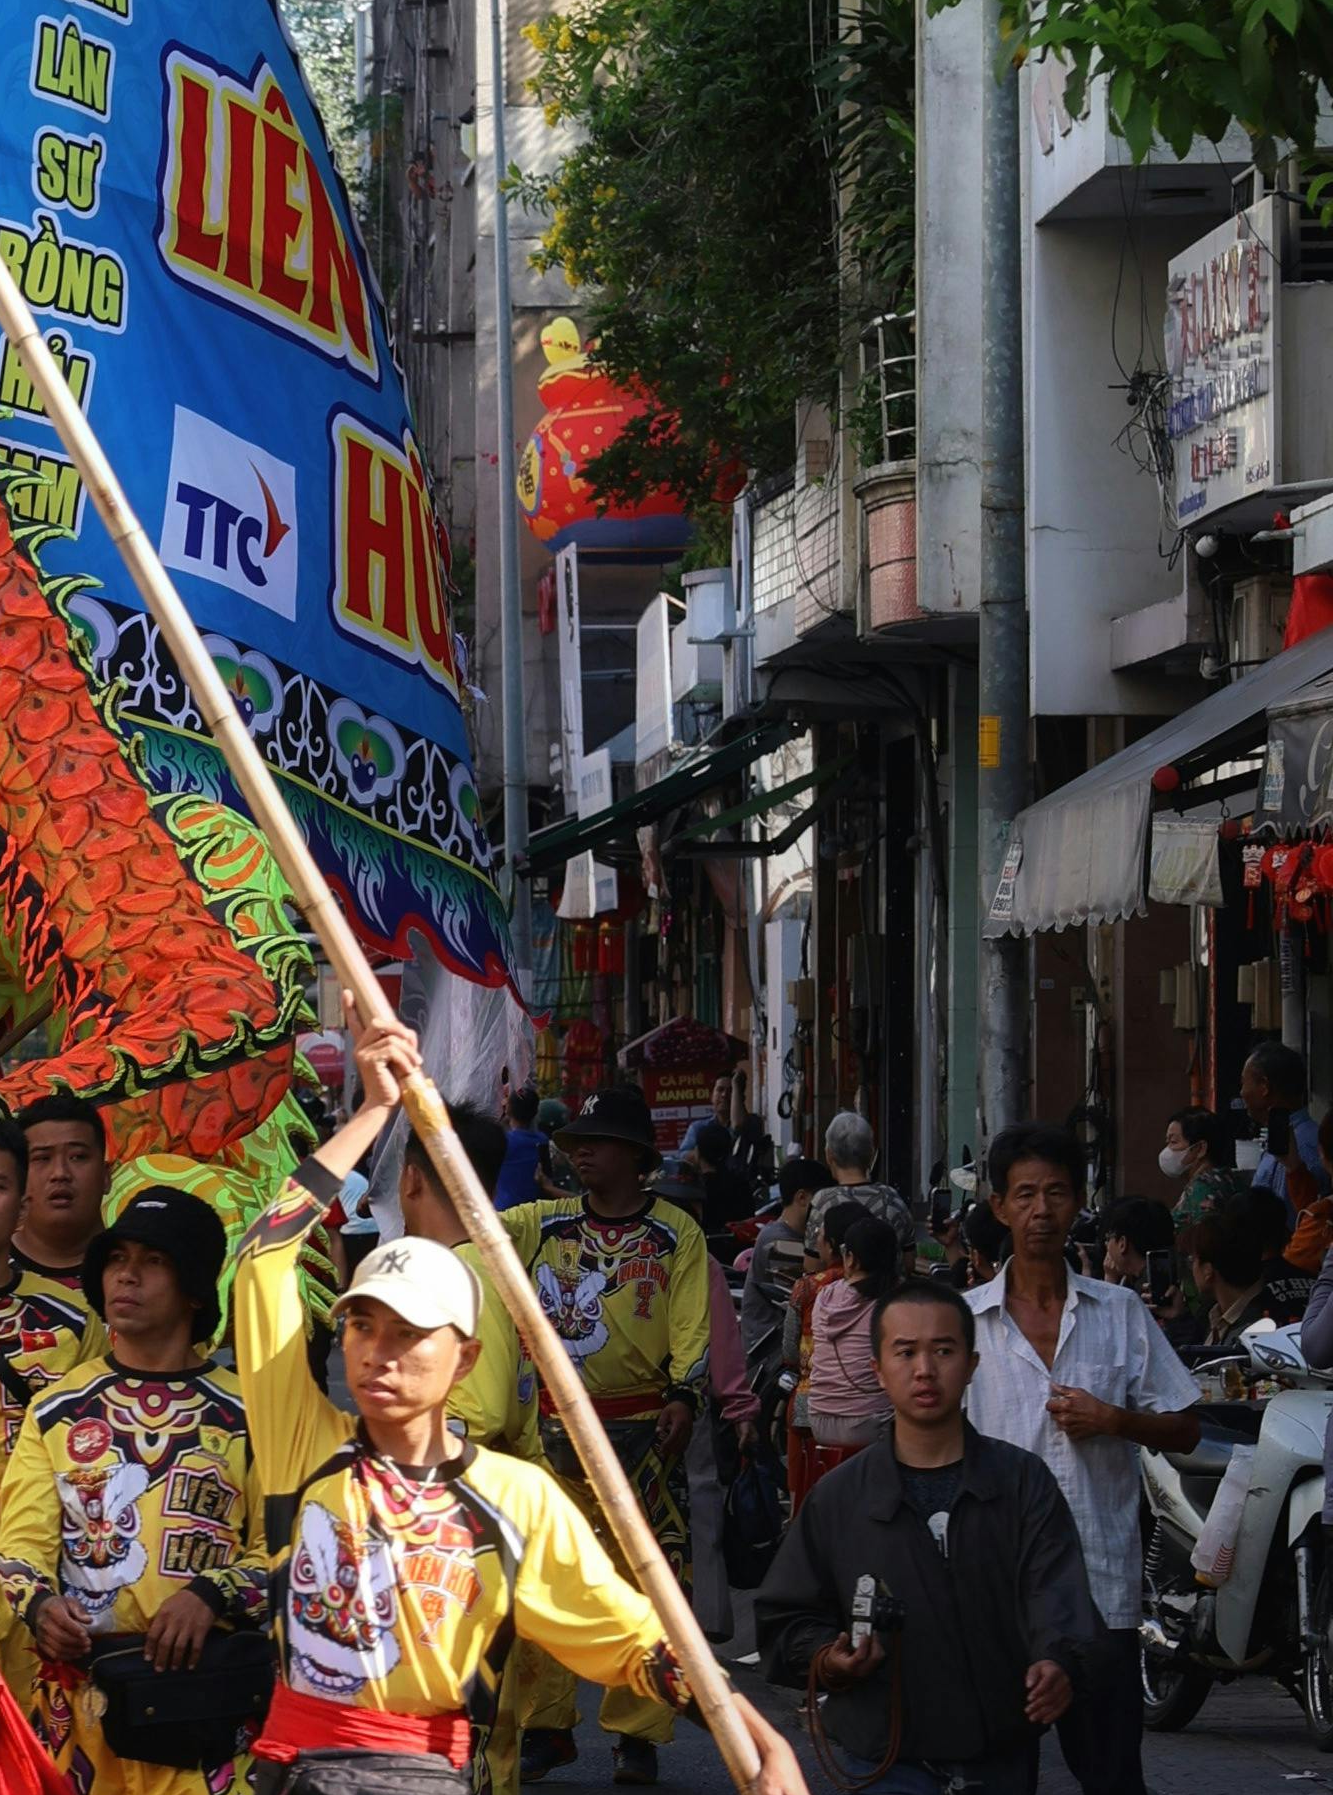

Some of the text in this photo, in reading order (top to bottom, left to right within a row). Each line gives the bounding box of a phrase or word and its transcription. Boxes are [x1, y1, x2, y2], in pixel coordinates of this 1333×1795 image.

[35, 20, 111, 116] LÂN
[37, 132, 102, 209] SƯ
[170, 71, 373, 362] LIÊN
[176, 481, 269, 588] TTC
